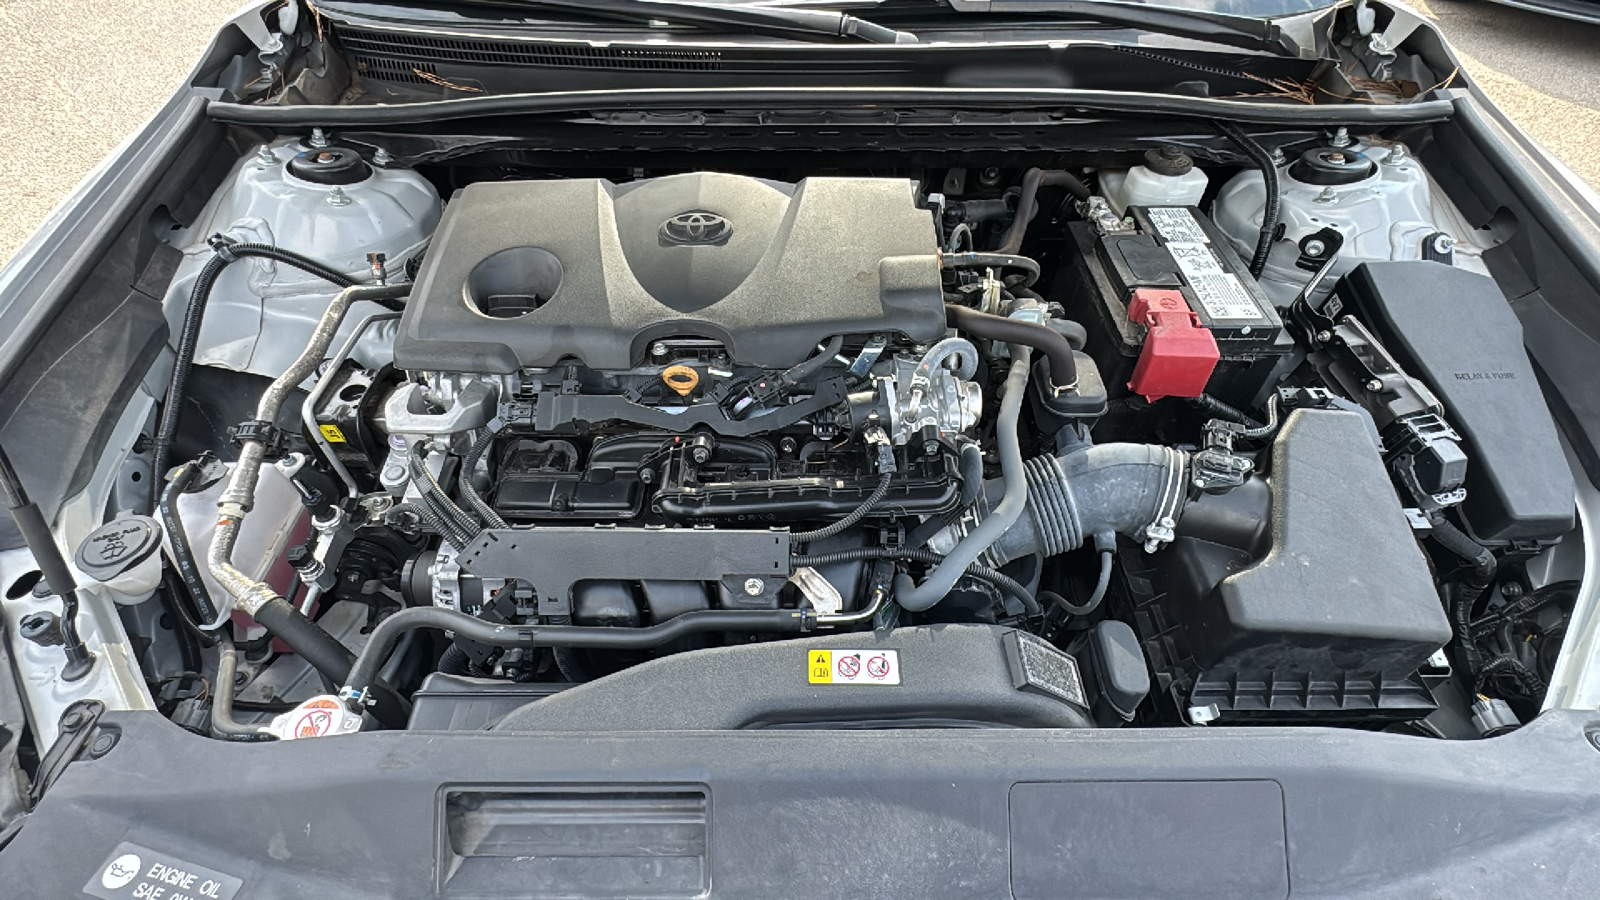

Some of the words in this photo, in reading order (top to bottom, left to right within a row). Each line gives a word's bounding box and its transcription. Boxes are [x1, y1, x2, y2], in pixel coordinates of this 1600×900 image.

[132, 882, 166, 900] SAE
[146, 862, 199, 889] ENGINE
[199, 879, 222, 899] OIL
